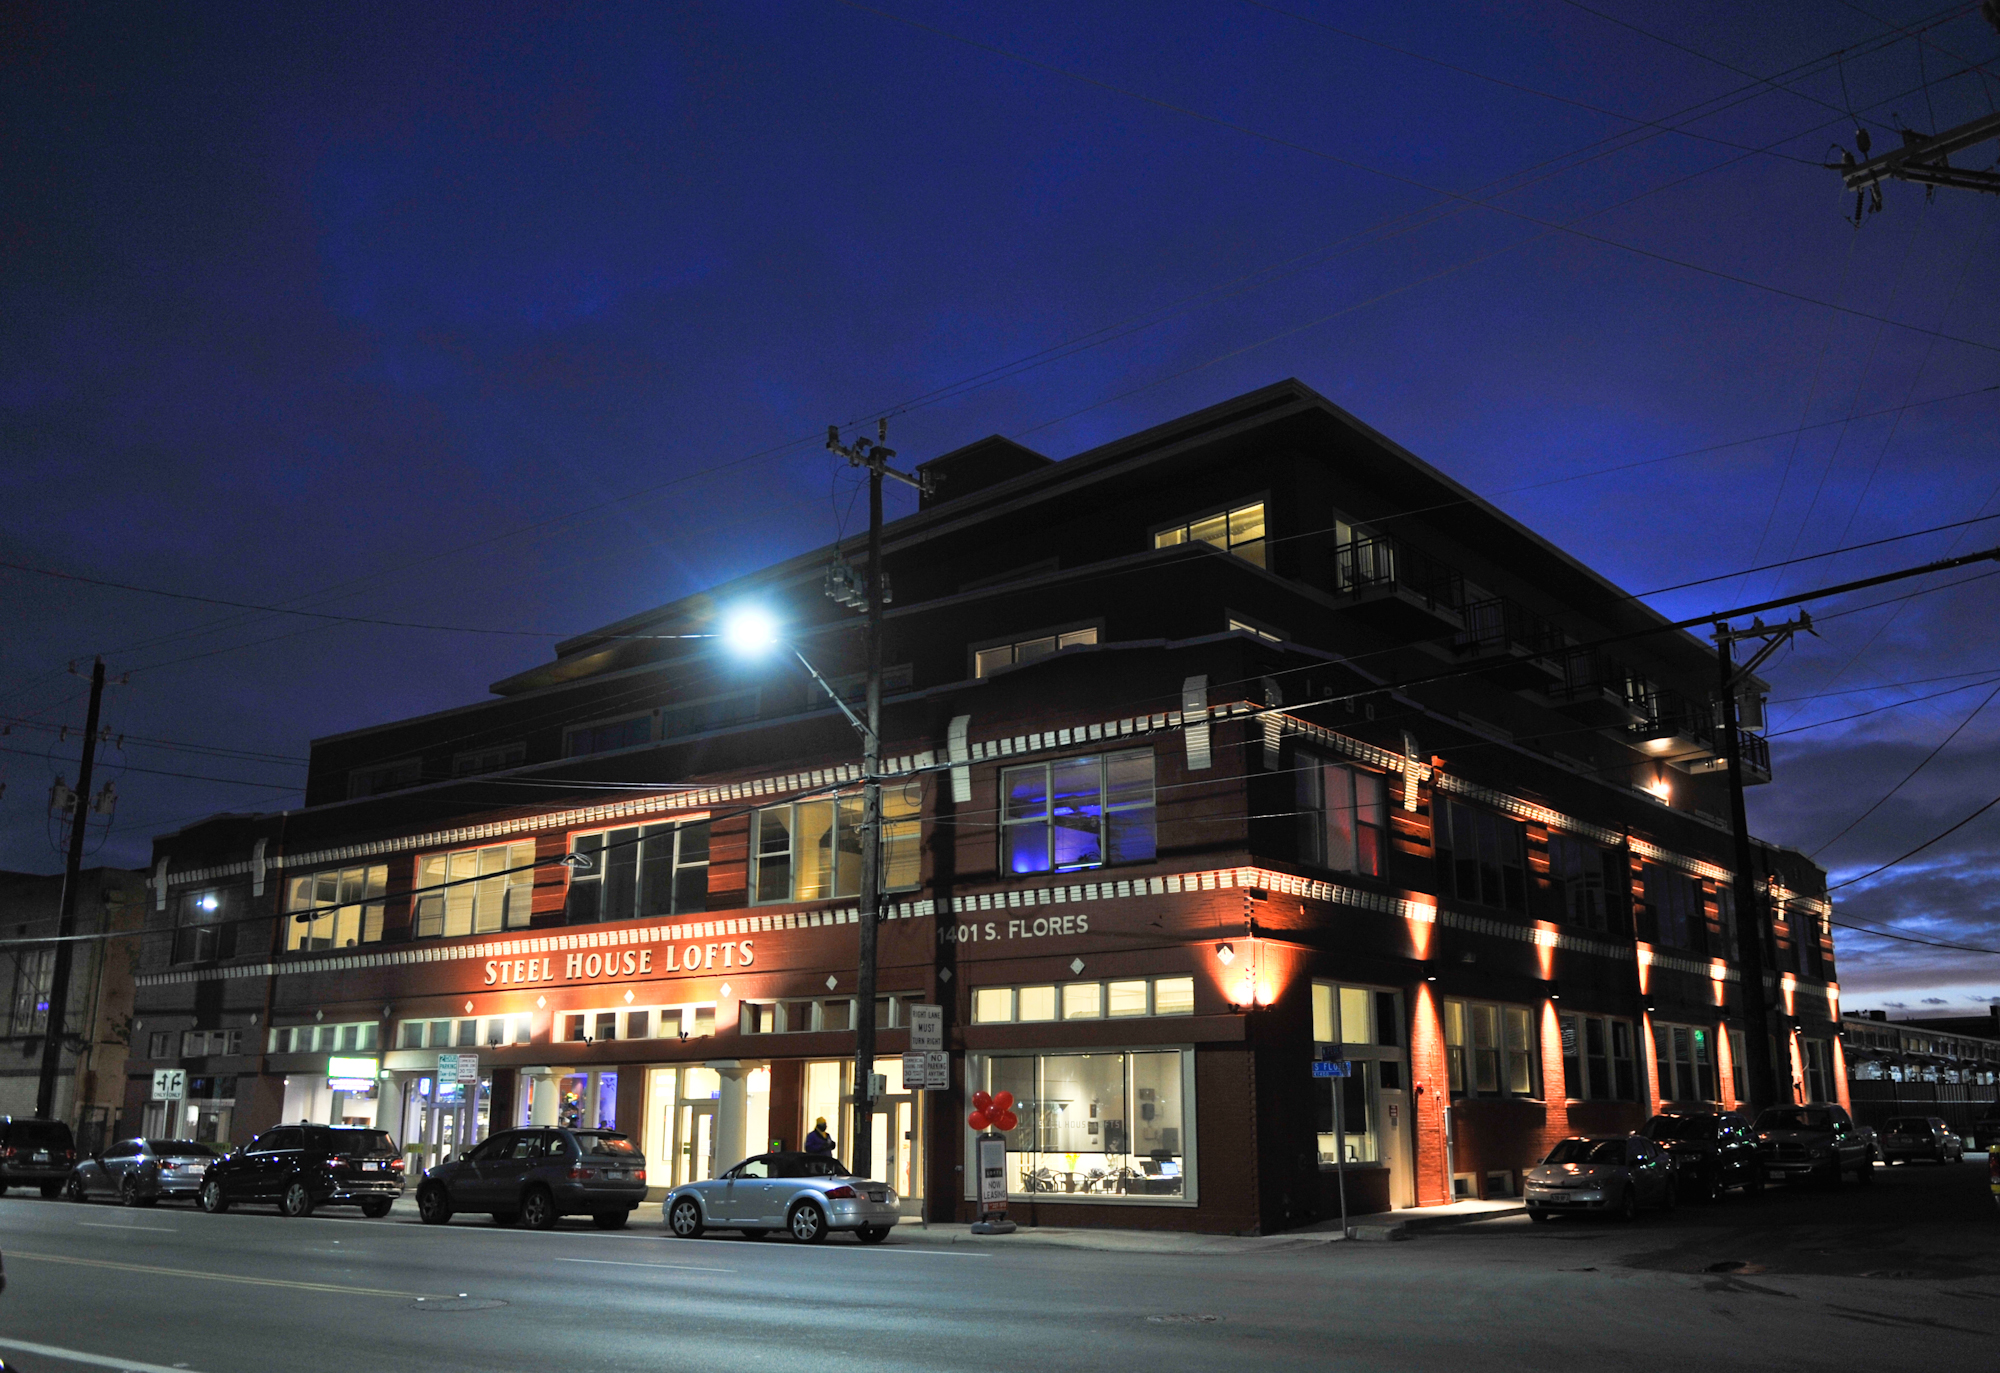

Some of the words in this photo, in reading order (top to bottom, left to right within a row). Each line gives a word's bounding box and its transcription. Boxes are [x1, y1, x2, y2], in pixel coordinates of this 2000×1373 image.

[937, 923, 978, 945] 1401
[984, 922, 1002, 941] S.
[1008, 914, 1089, 939] FLORES
[484, 957, 554, 985] STEEL
[565, 949, 652, 978] HOUSE
[665, 940, 754, 972] LOFTS
[912, 1010, 926, 1019] RIGHT
[928, 1011, 941, 1019] LANE
[918, 1023, 935, 1033] MUST
[912, 1037, 925, 1045] TURN
[926, 1037, 941, 1045] RIGHT
[930, 1054, 943, 1062] NO
[927, 1062, 947, 1070] PARKING
[1314, 1062, 1319, 1071] S
[988, 1180, 1001, 1189] NOW
[983, 1190, 1006, 1200] LEASING
